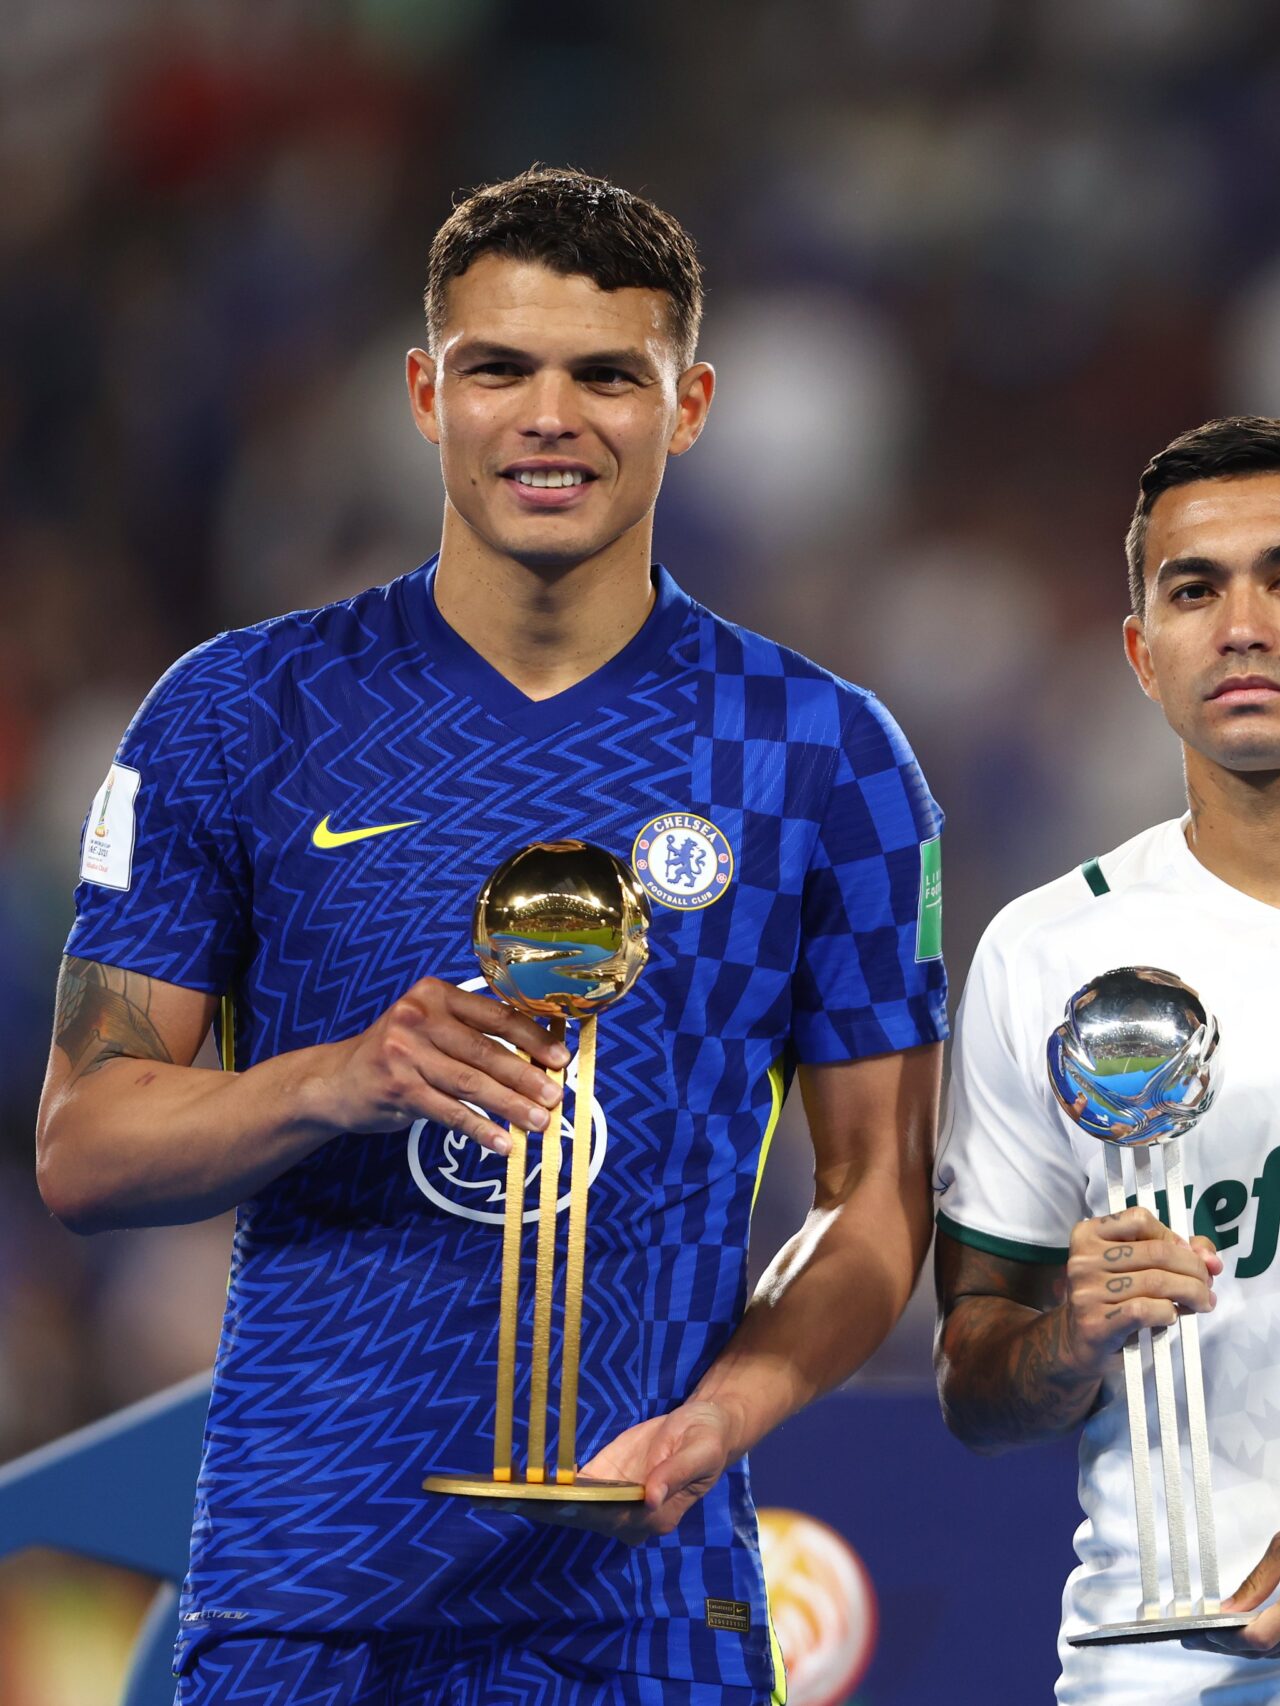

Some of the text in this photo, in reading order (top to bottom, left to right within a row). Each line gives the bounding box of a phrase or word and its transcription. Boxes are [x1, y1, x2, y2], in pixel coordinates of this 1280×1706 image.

[653, 816, 717, 843] CHELSEA
[647, 881, 713, 905] FOOTBALL CLUB
